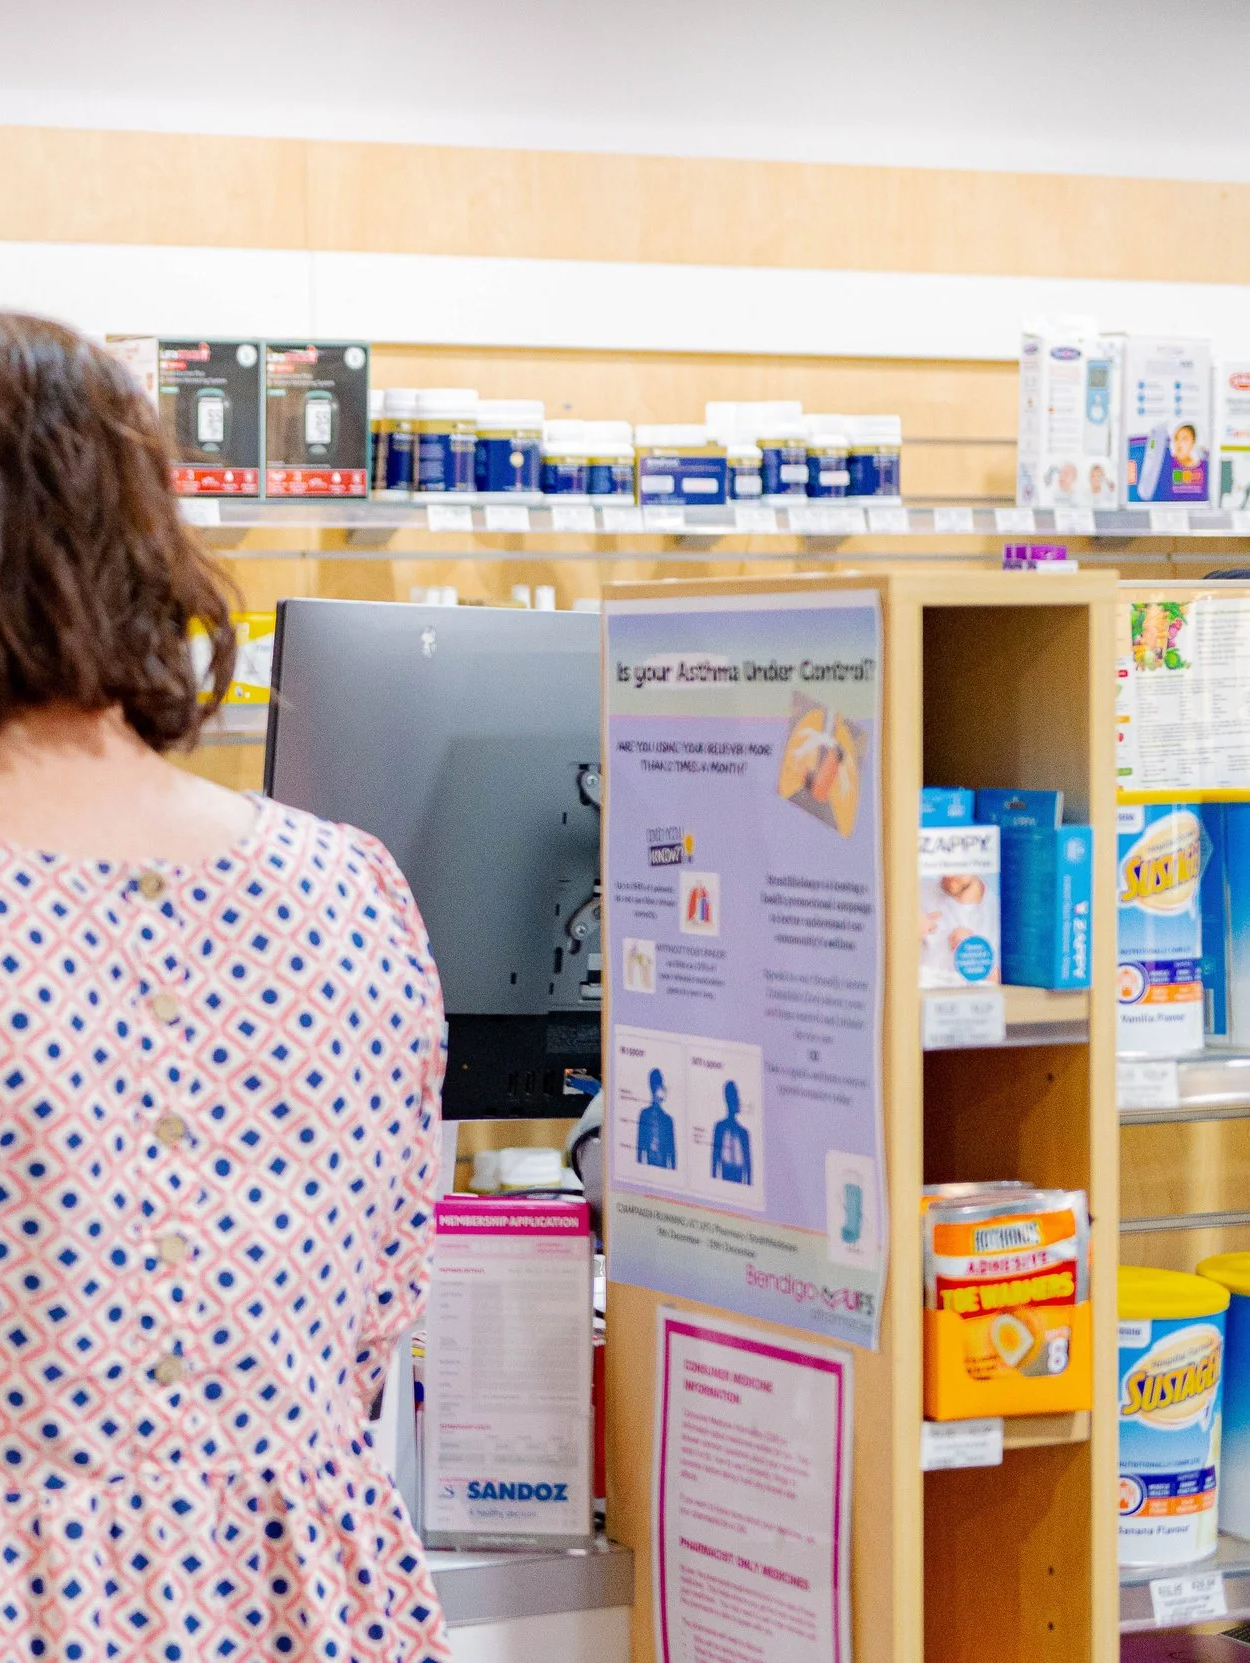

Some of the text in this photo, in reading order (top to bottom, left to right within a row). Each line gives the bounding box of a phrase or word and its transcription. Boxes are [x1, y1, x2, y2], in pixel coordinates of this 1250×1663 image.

[617, 662, 630, 682] Is
[634, 665, 671, 688] your
[677, 660, 739, 682] Asthma
[743, 660, 793, 682] Under
[439, 1215, 580, 1229] MEMBERSHIP APPLICATION
[746, 1262, 818, 1303] Bendigo
[940, 1271, 1075, 1313] TOE WARMERS
[467, 1479, 569, 1503] SANDOZ
